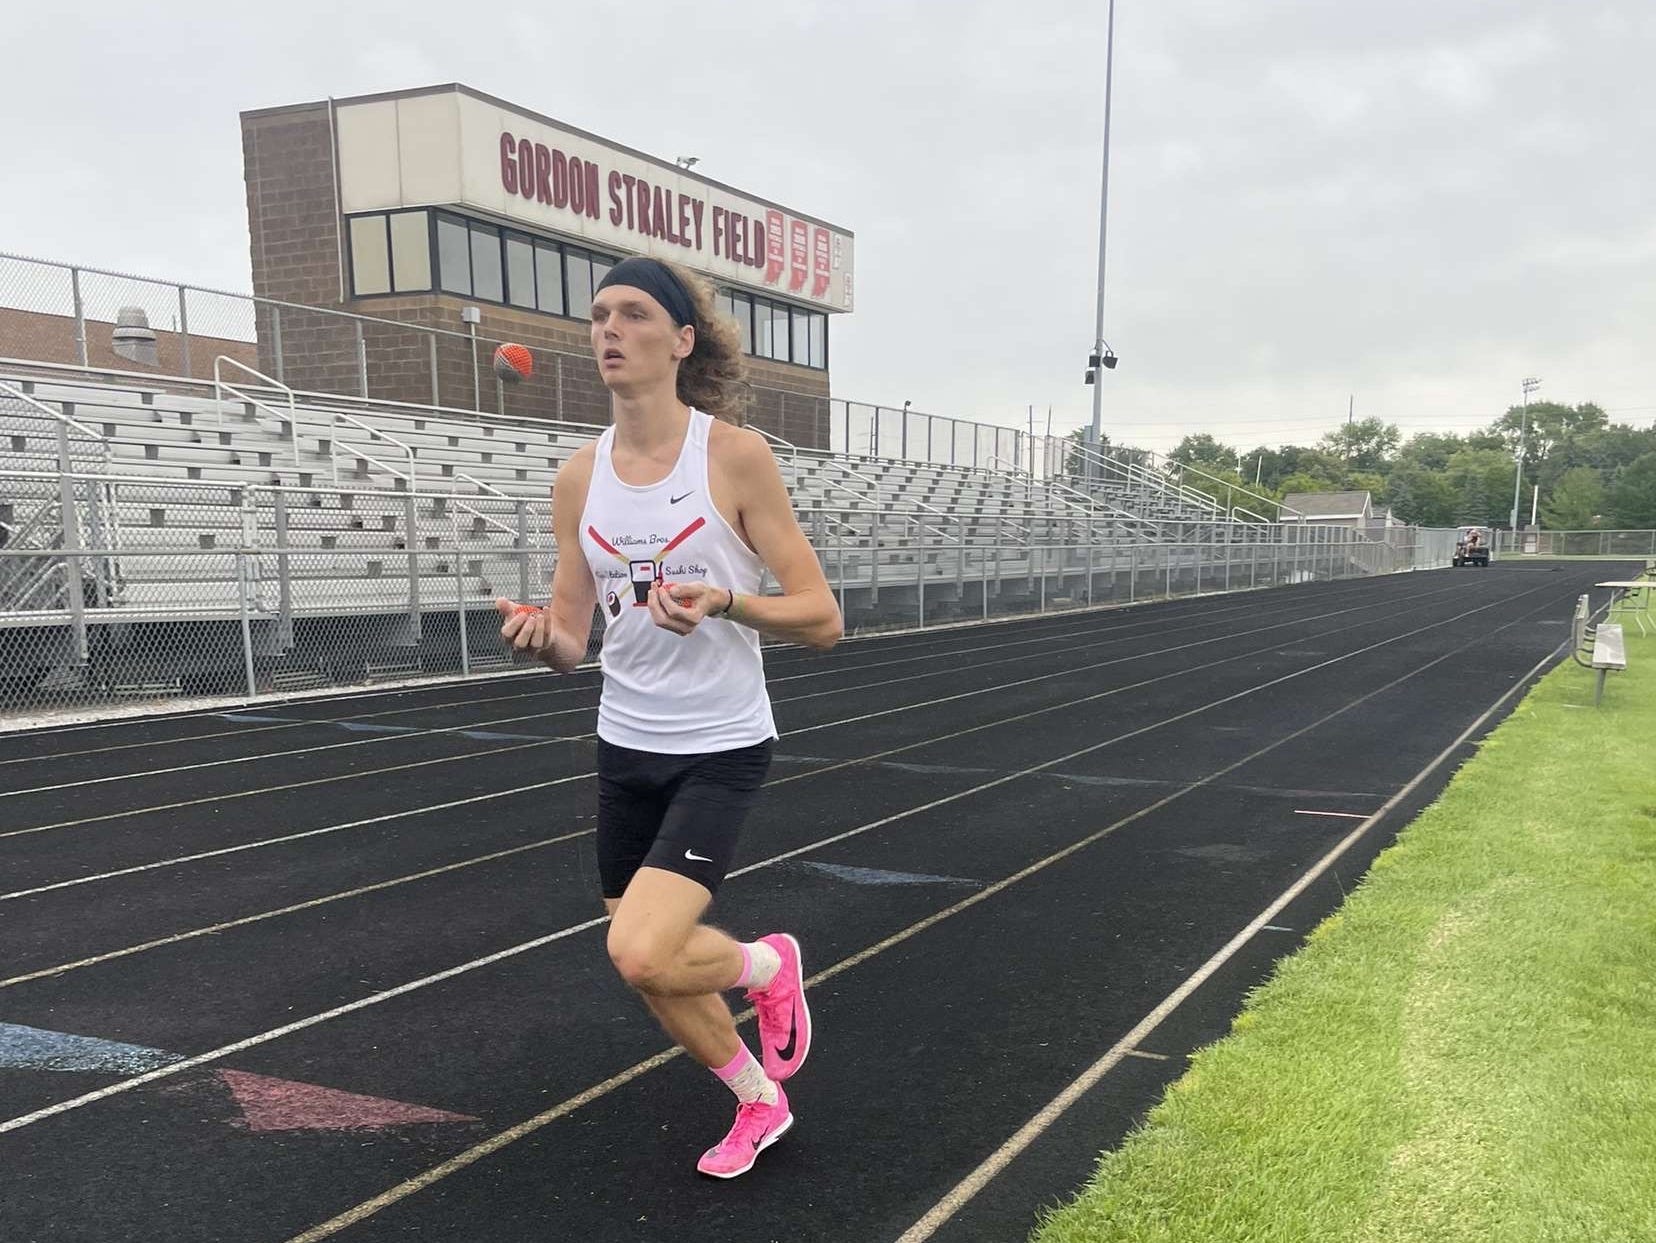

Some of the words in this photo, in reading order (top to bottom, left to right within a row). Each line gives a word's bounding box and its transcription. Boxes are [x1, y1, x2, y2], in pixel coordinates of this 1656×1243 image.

[500, 132, 600, 220] GORDON
[608, 170, 704, 251] STRALEY
[712, 205, 766, 269] FIELD
